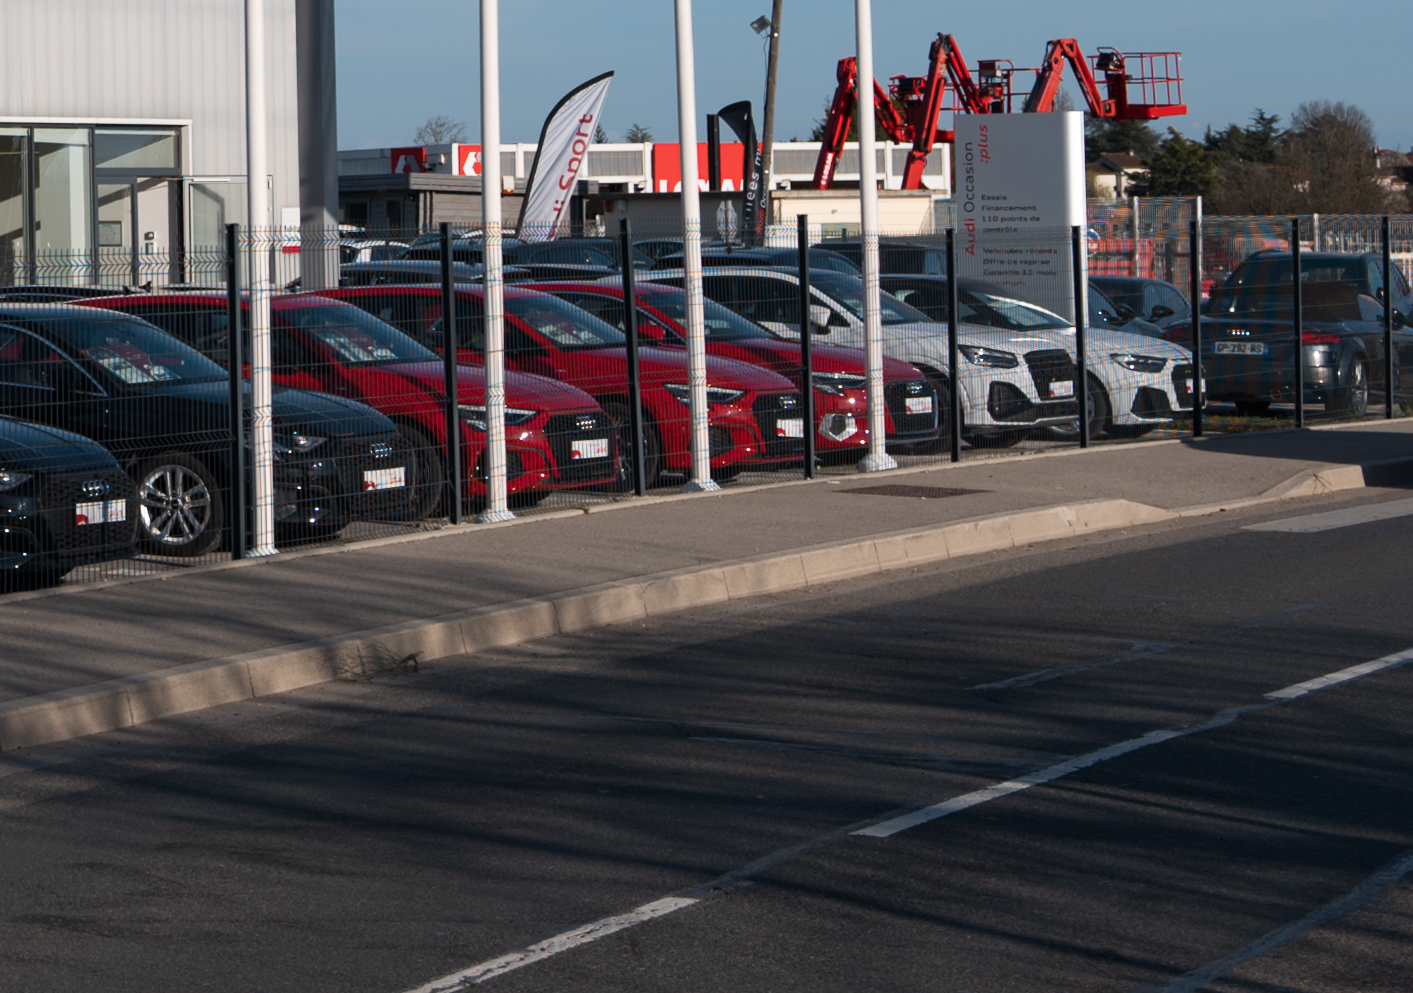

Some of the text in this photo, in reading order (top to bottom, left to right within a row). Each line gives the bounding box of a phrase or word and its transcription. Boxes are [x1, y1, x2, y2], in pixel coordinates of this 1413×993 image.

[559, 113, 593, 191] Sport
[977, 124, 991, 164] :plus
[963, 142, 976, 256] Audi Occasion
